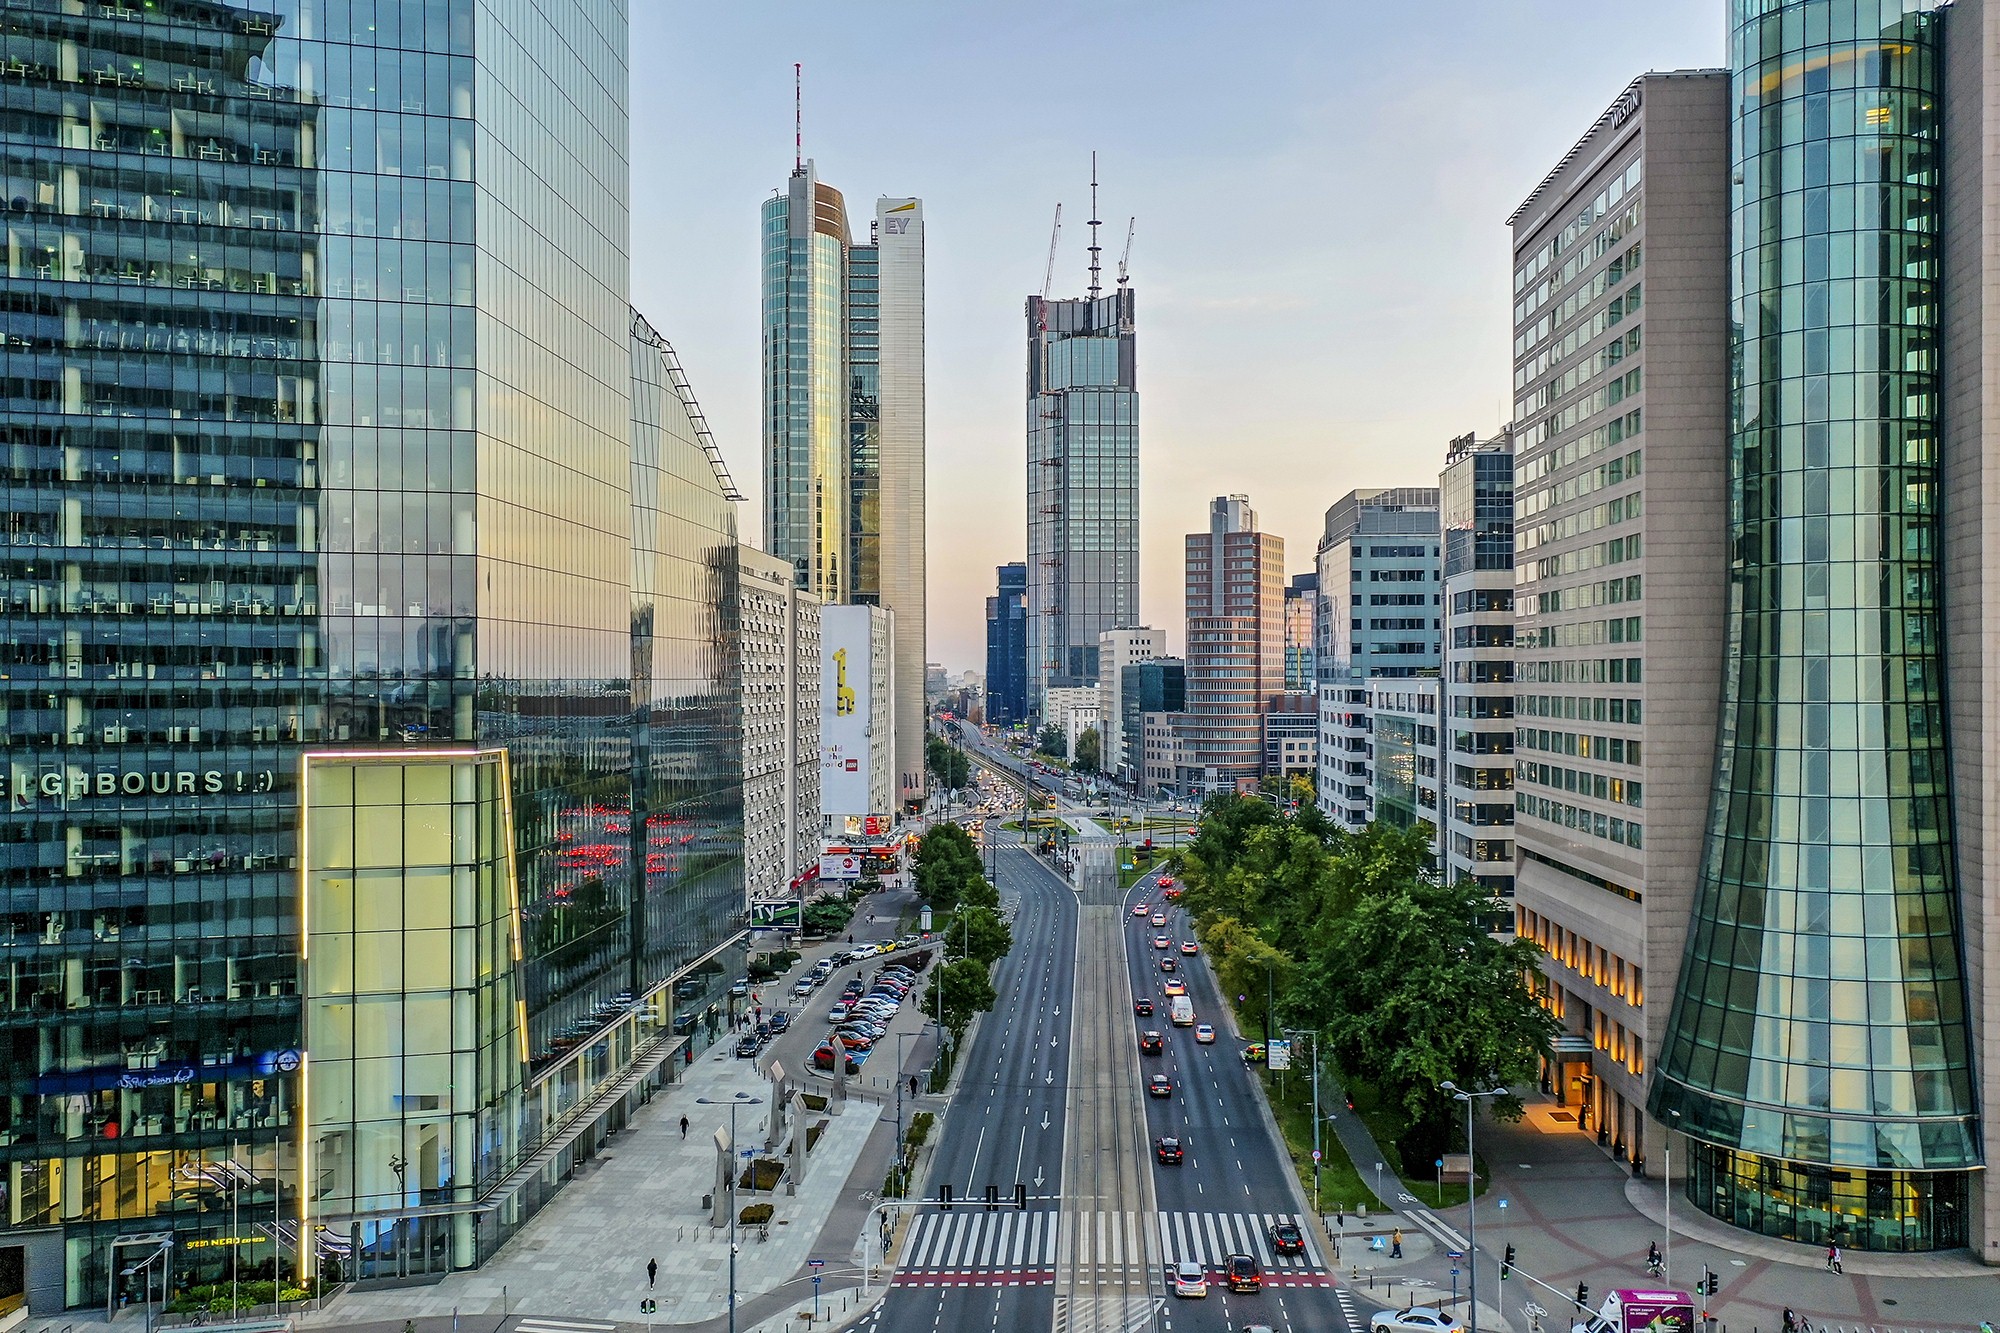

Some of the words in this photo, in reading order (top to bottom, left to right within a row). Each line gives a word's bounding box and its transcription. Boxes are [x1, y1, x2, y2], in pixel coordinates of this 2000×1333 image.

[1610, 90, 1642, 130] WESTIN
[885, 217, 911, 235] EY
[753, 904, 775, 922] Ty
[186, 1240, 209, 1250] green
